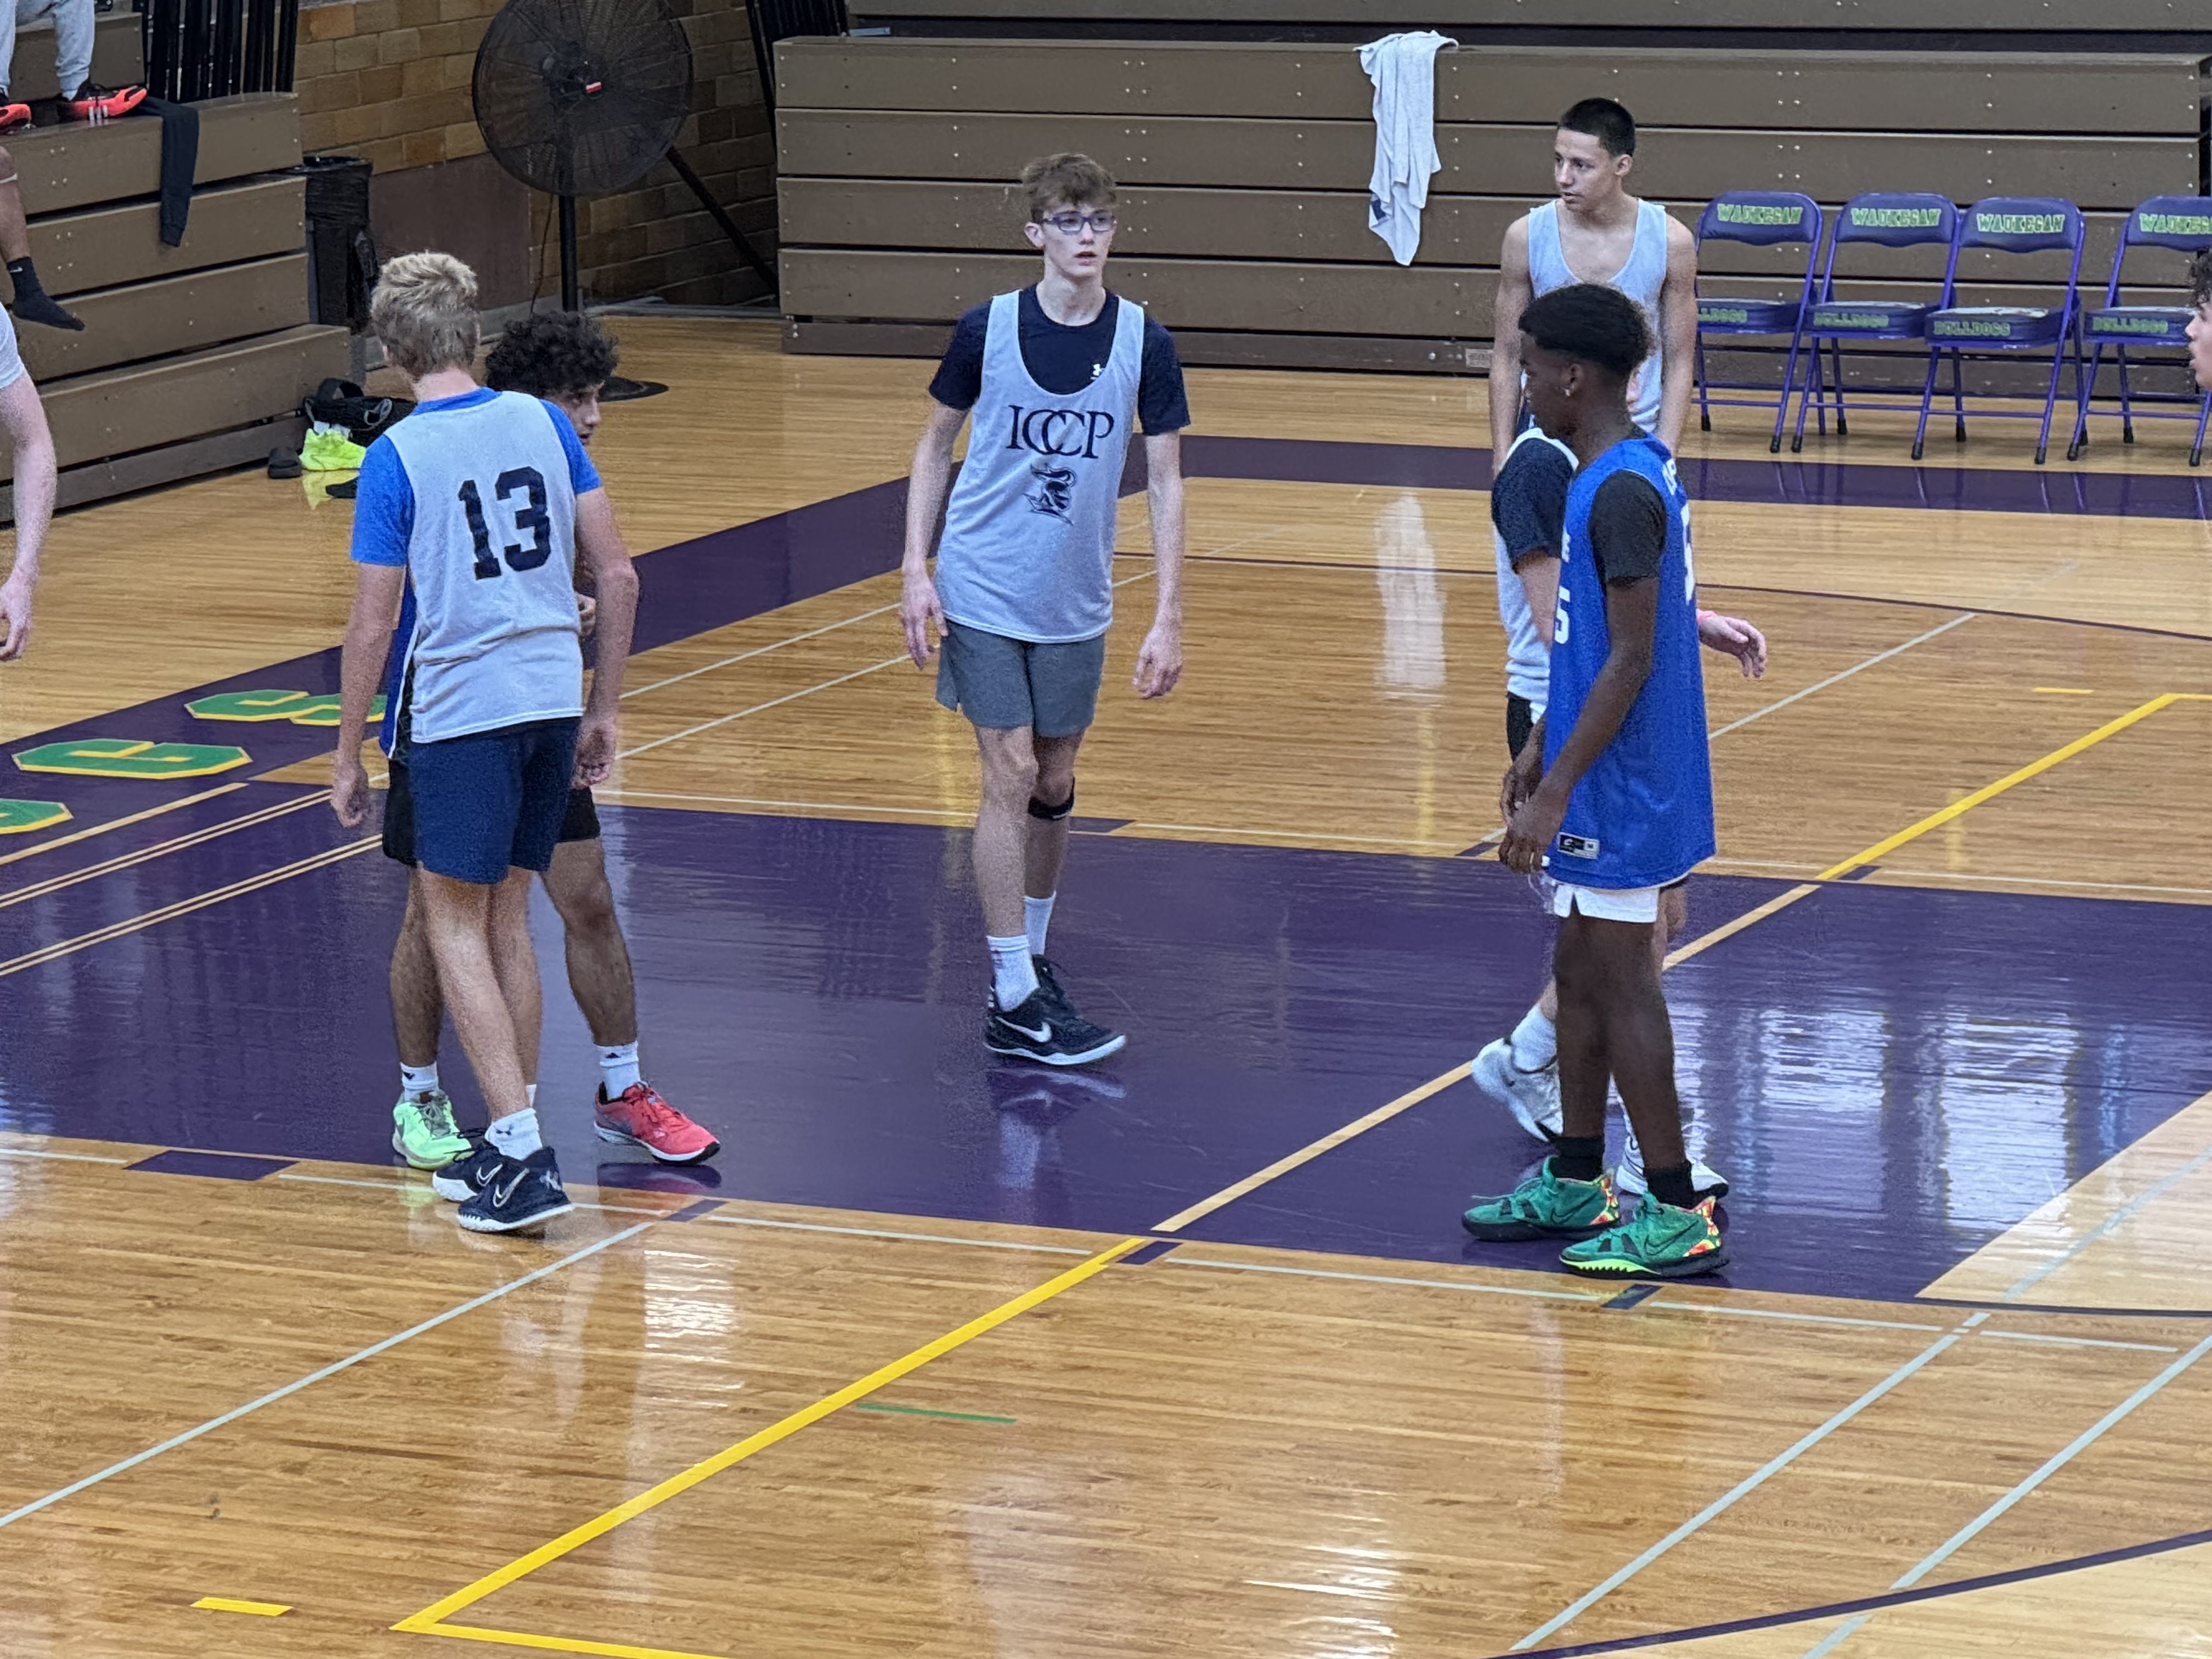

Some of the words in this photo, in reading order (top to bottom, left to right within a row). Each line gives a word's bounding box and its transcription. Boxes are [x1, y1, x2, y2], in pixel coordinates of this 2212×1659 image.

[1717, 203, 1804, 225] WAUKEGAN
[1850, 208, 1942, 227] WAUKEGAN
[1976, 213, 2065, 234] WAUKEGAN
[1006, 405, 1114, 459] ICCP
[458, 466, 551, 580] 13
